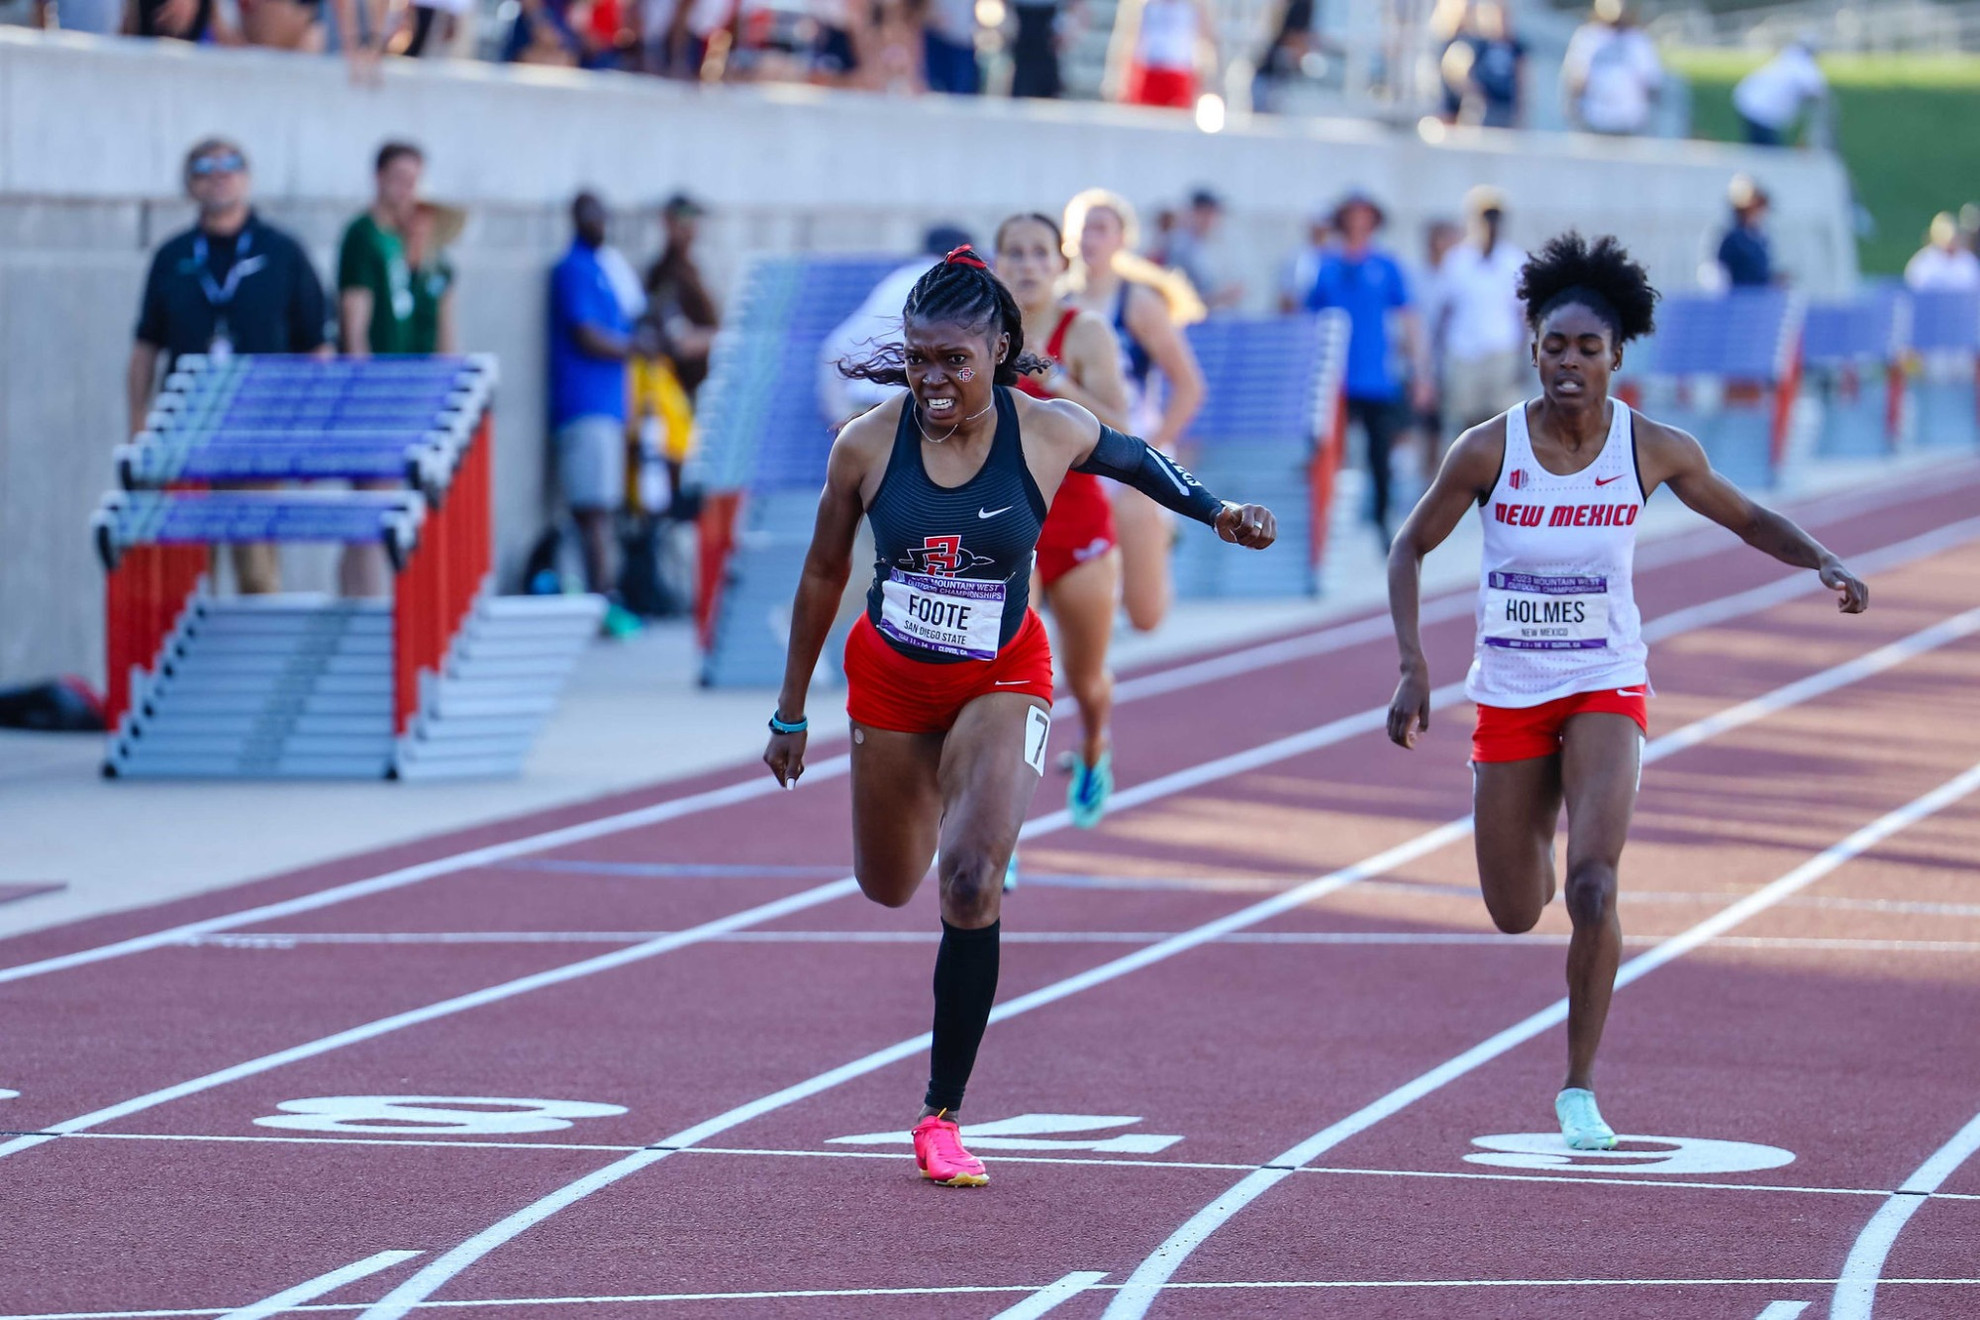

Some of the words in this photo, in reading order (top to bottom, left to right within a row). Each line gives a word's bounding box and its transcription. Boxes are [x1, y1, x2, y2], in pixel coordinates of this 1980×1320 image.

[1495, 503, 1545, 527] NEW
[1548, 504, 1639, 527] MEXICO
[976, 584, 999, 592] WEST
[1533, 577, 1576, 586] MOUNTAIN
[939, 588, 1002, 600] CHAMPIONSHIPS
[908, 594, 972, 631] FOOTE
[1506, 598, 1585, 623] HOLMES
[904, 620, 919, 634] SAN
[919, 626, 940, 640] DIEGO
[941, 632, 967, 645] STATE
[1521, 628, 1538, 637] NEW
[1539, 628, 1569, 637] MEXICO
[1032, 712, 1048, 766] 7
[251, 1095, 630, 1135] 8
